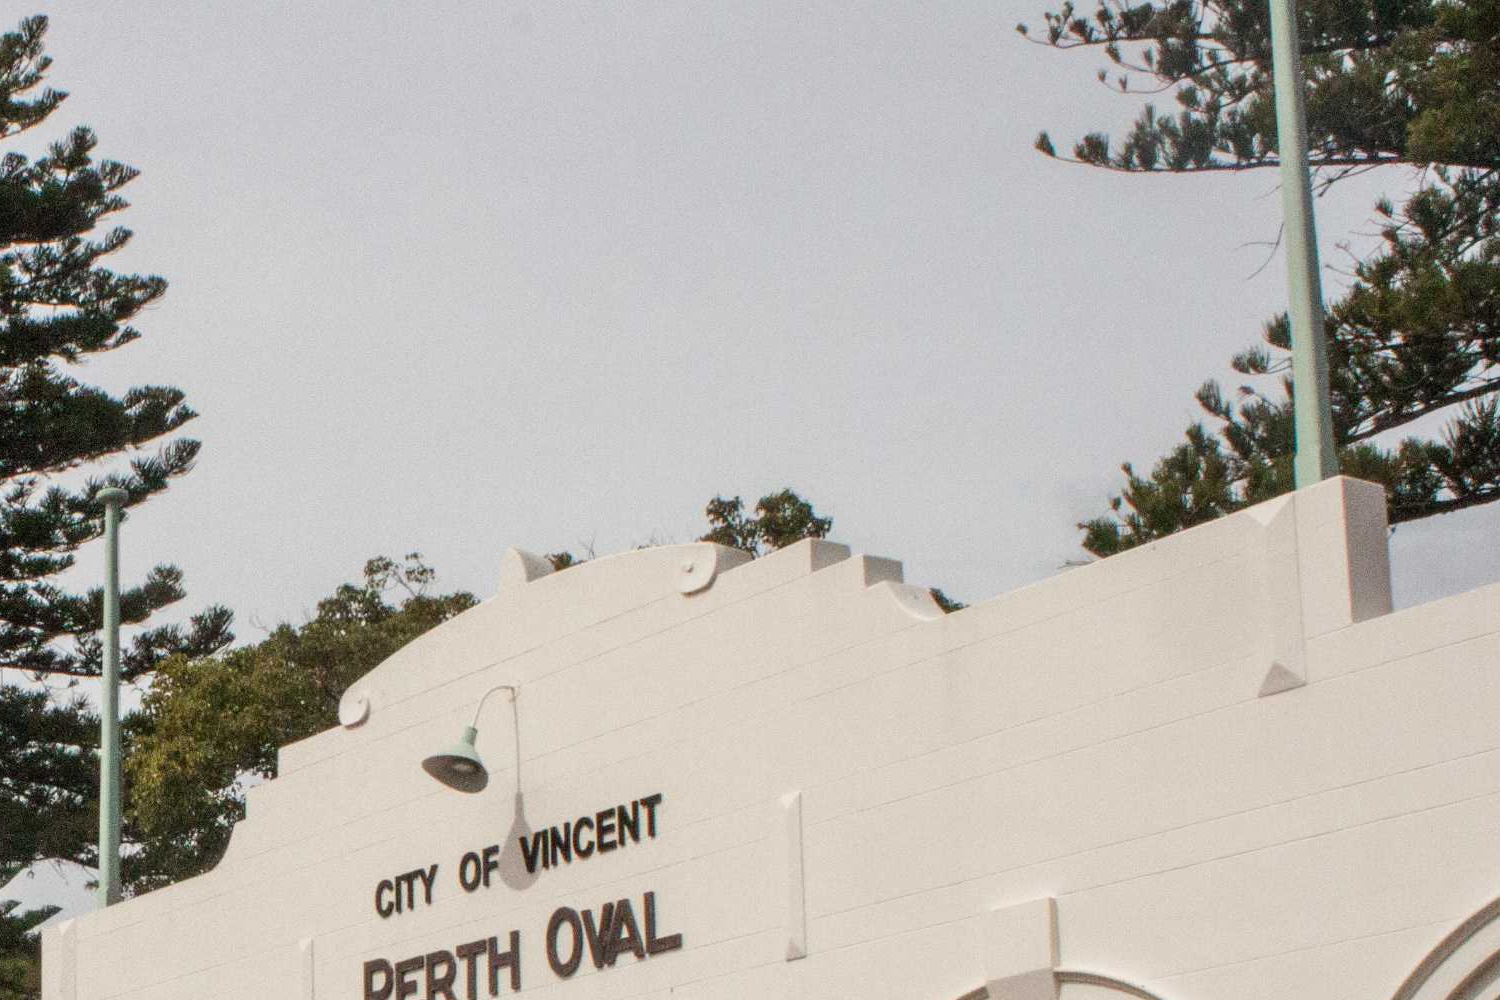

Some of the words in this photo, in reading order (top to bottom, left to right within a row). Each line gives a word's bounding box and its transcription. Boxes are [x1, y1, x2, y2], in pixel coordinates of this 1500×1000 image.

[375, 865, 438, 918] CITY
[460, 845, 500, 891] OF
[519, 793, 662, 874] VINCENT
[546, 891, 682, 979] OVAL
